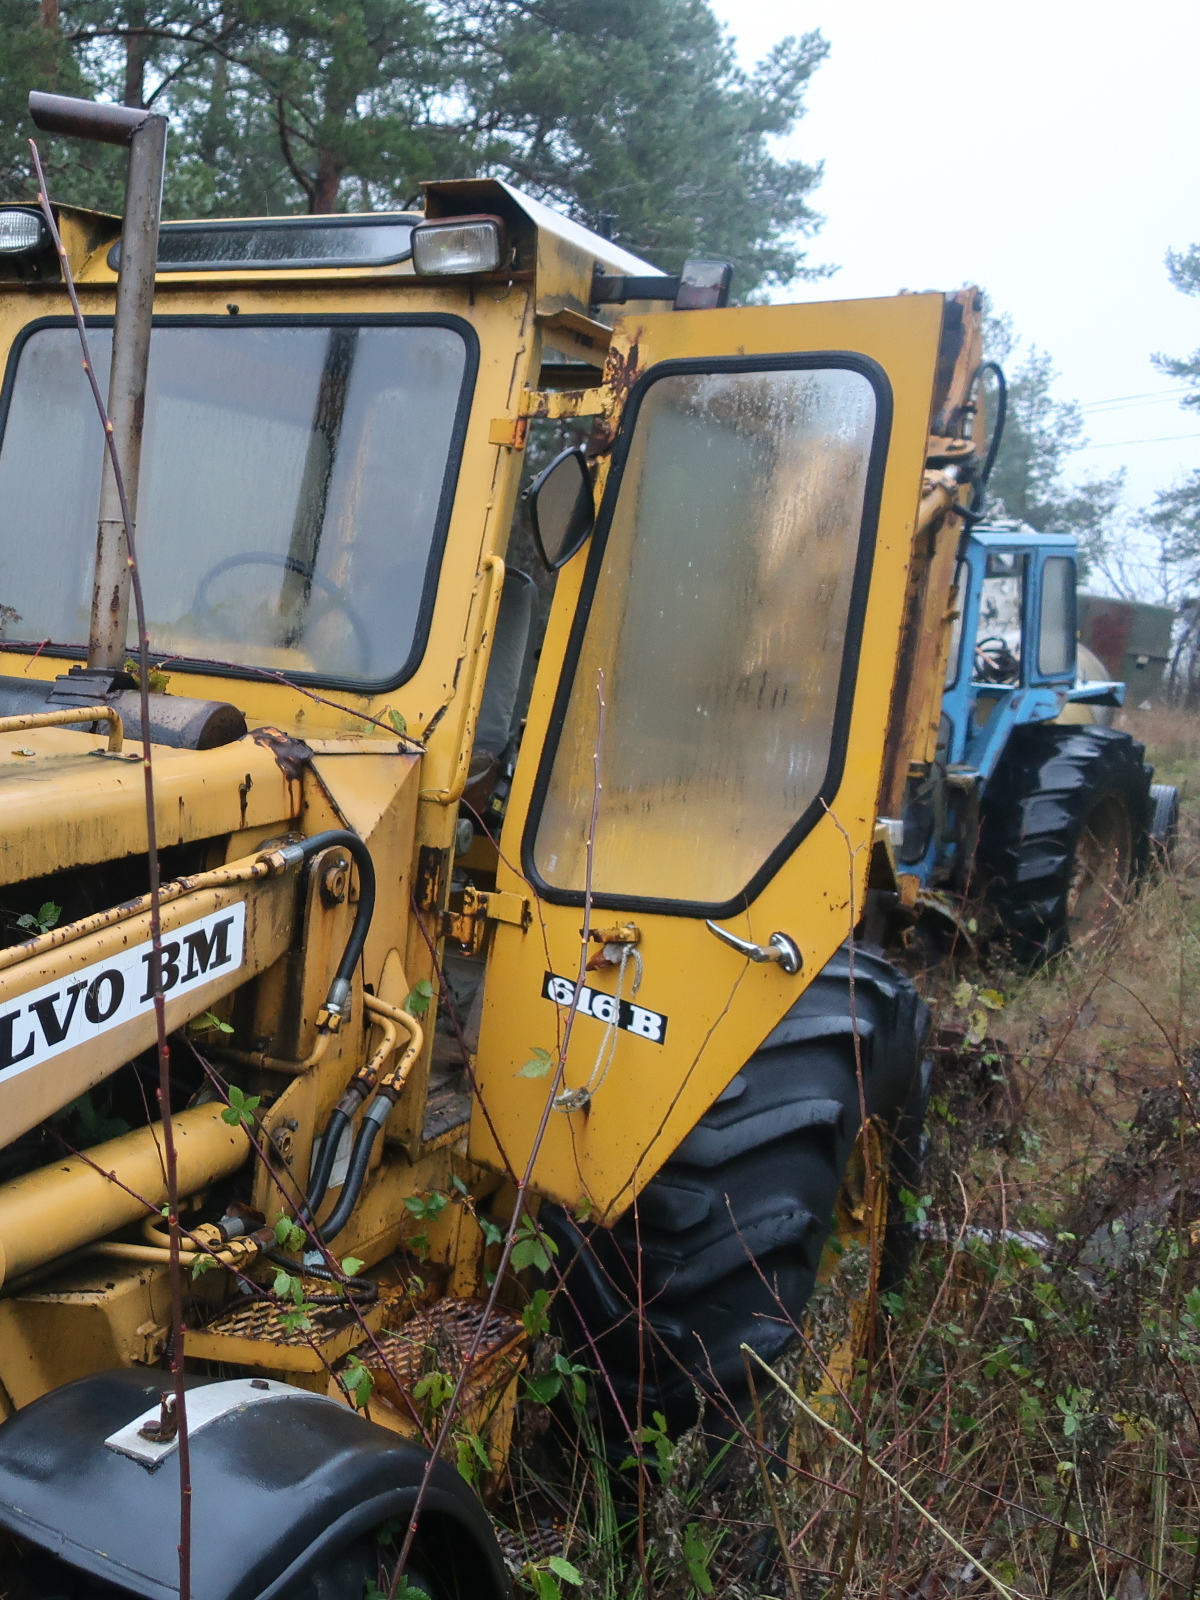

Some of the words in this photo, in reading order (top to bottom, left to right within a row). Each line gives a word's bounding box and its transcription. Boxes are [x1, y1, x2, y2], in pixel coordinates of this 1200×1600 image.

[140, 916, 234, 1003] BM
[547, 977, 620, 1023] 616
[627, 1005, 662, 1040] B
